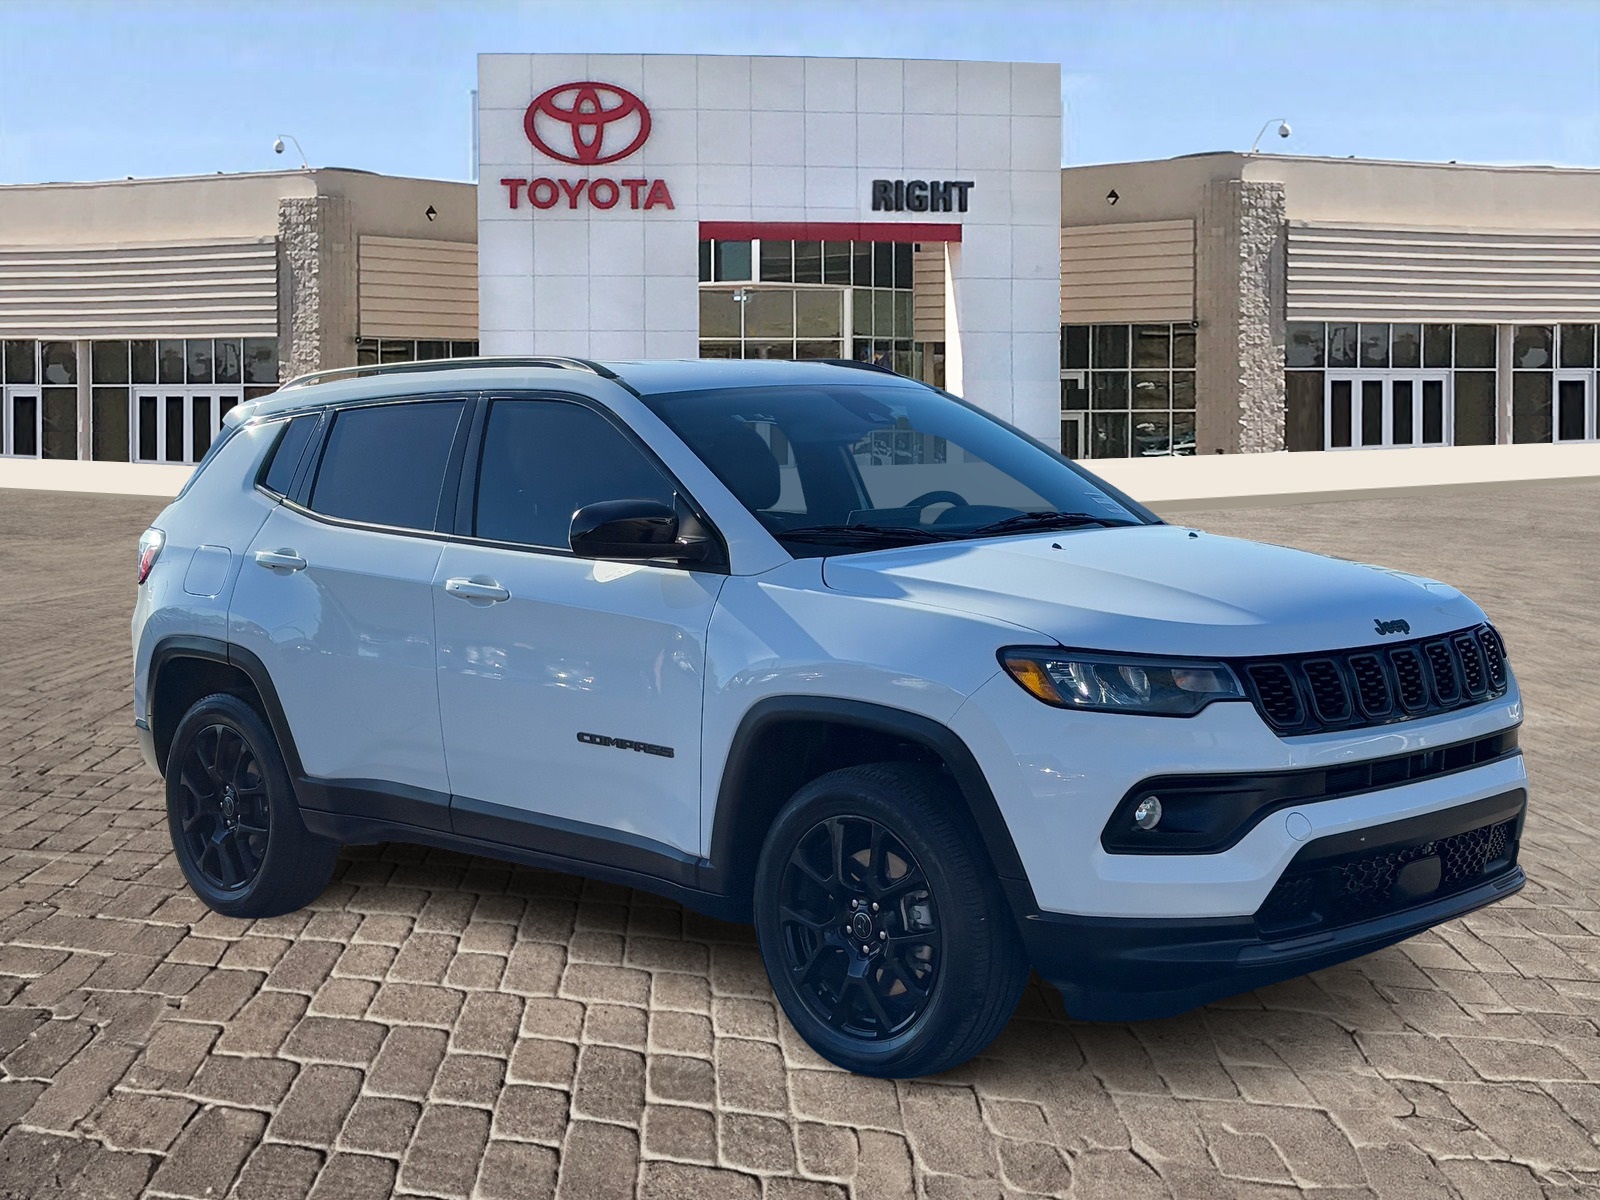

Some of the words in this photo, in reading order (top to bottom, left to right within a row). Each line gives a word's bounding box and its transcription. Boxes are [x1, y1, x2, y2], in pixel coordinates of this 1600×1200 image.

[500, 179, 675, 209] TOYOTA
[871, 180, 975, 212] RIGHT
[1373, 618, 1411, 636] Jeep
[576, 731, 675, 758] COMPASS
